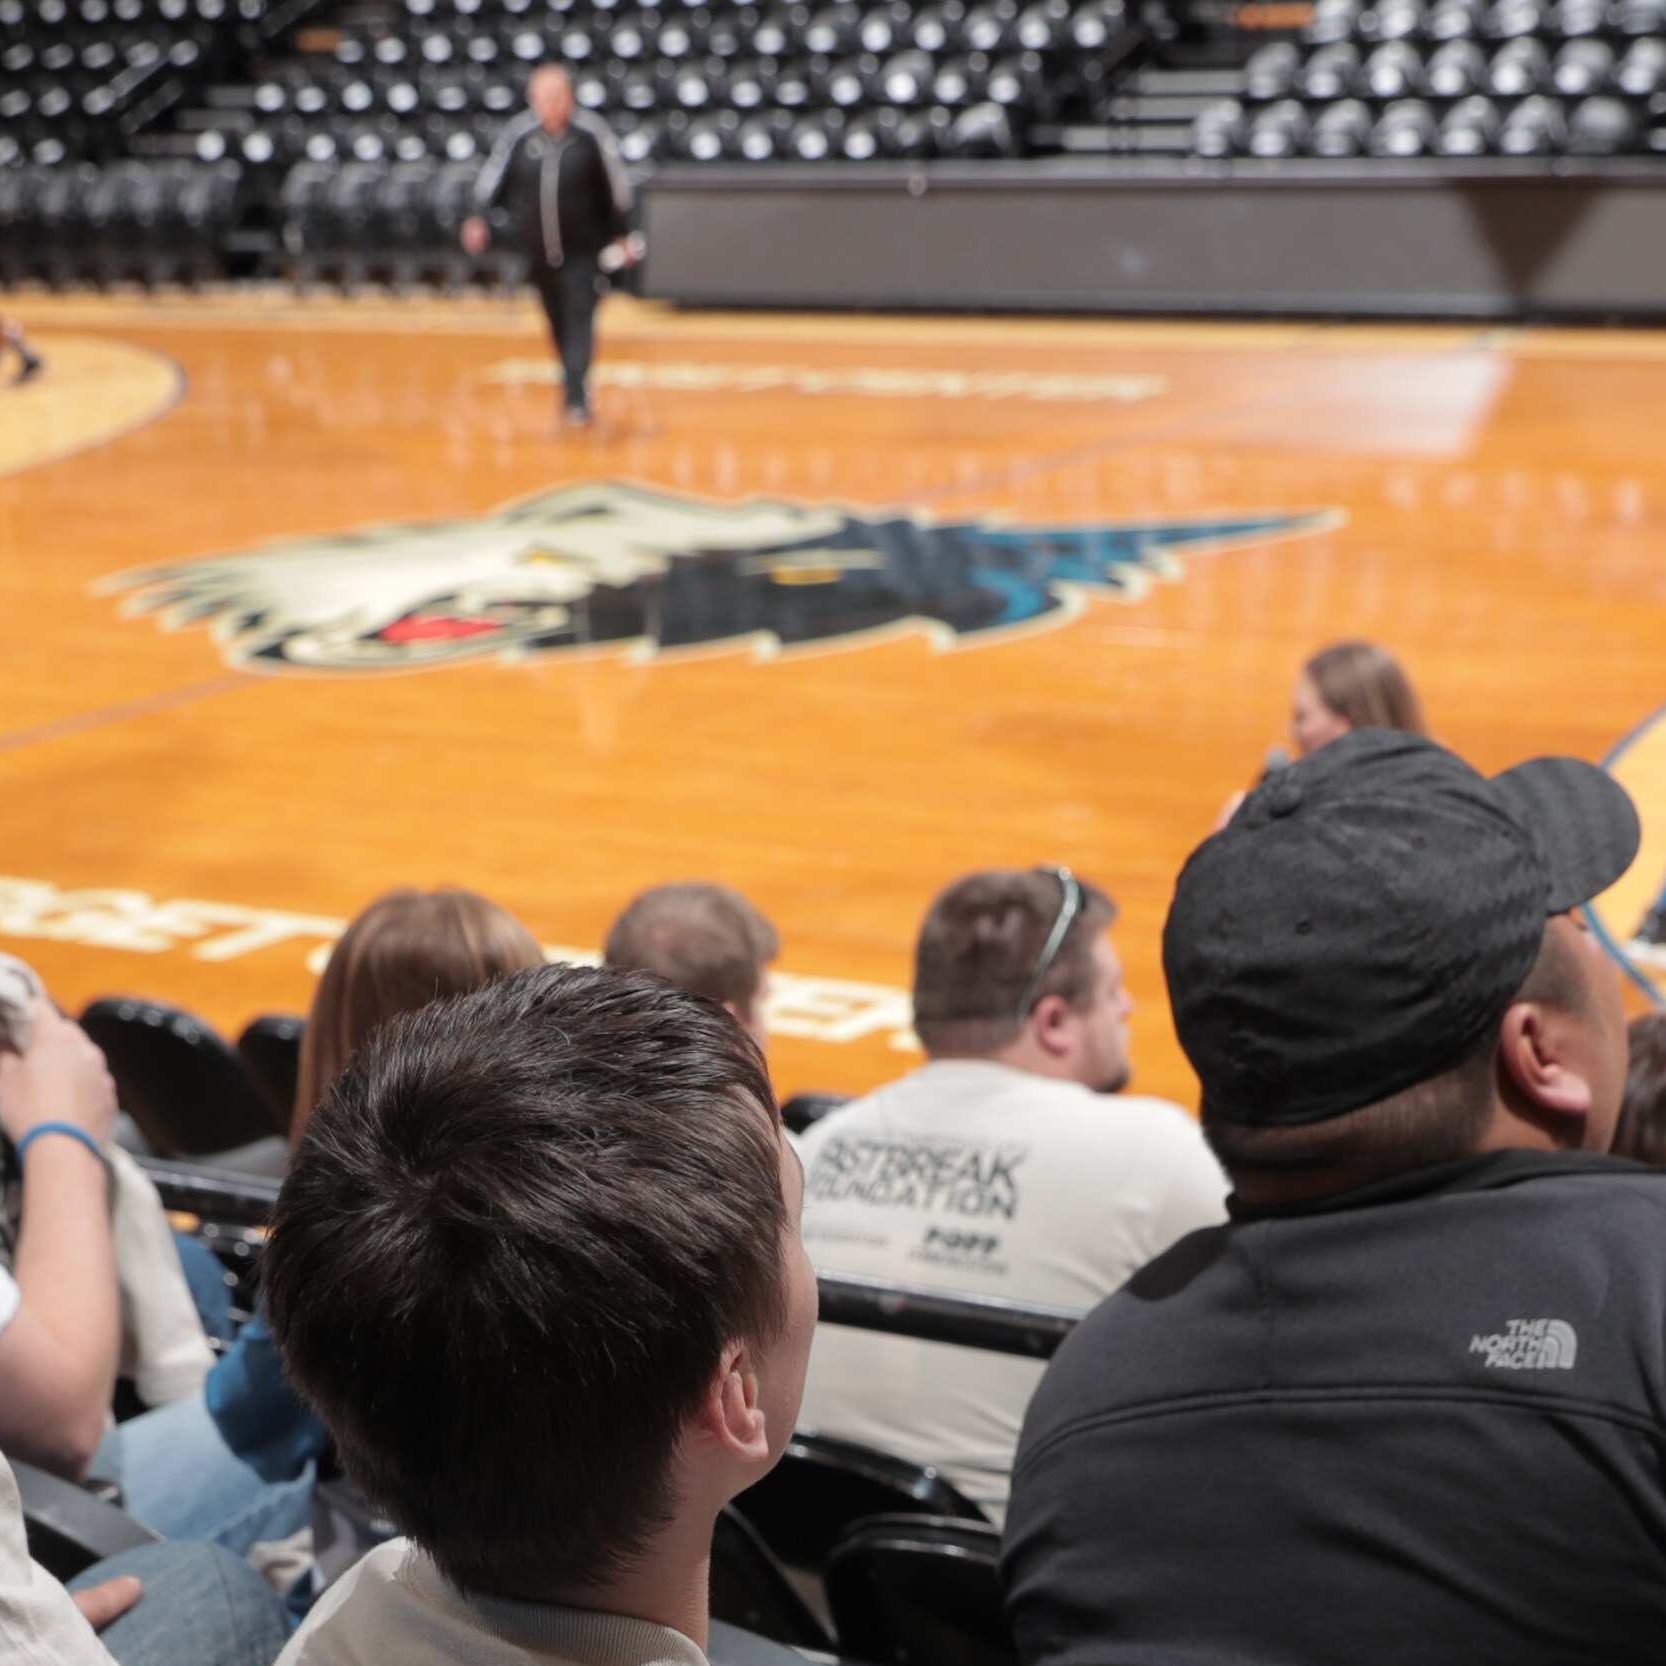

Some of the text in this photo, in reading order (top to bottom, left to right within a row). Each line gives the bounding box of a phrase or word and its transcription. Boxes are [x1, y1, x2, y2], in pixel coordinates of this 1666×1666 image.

[808, 1168, 1019, 1220] UNDATION
[1505, 1318, 1549, 1336] THE
[1468, 1333, 1544, 1354] NORTH
[1483, 1350, 1539, 1370] FACE
